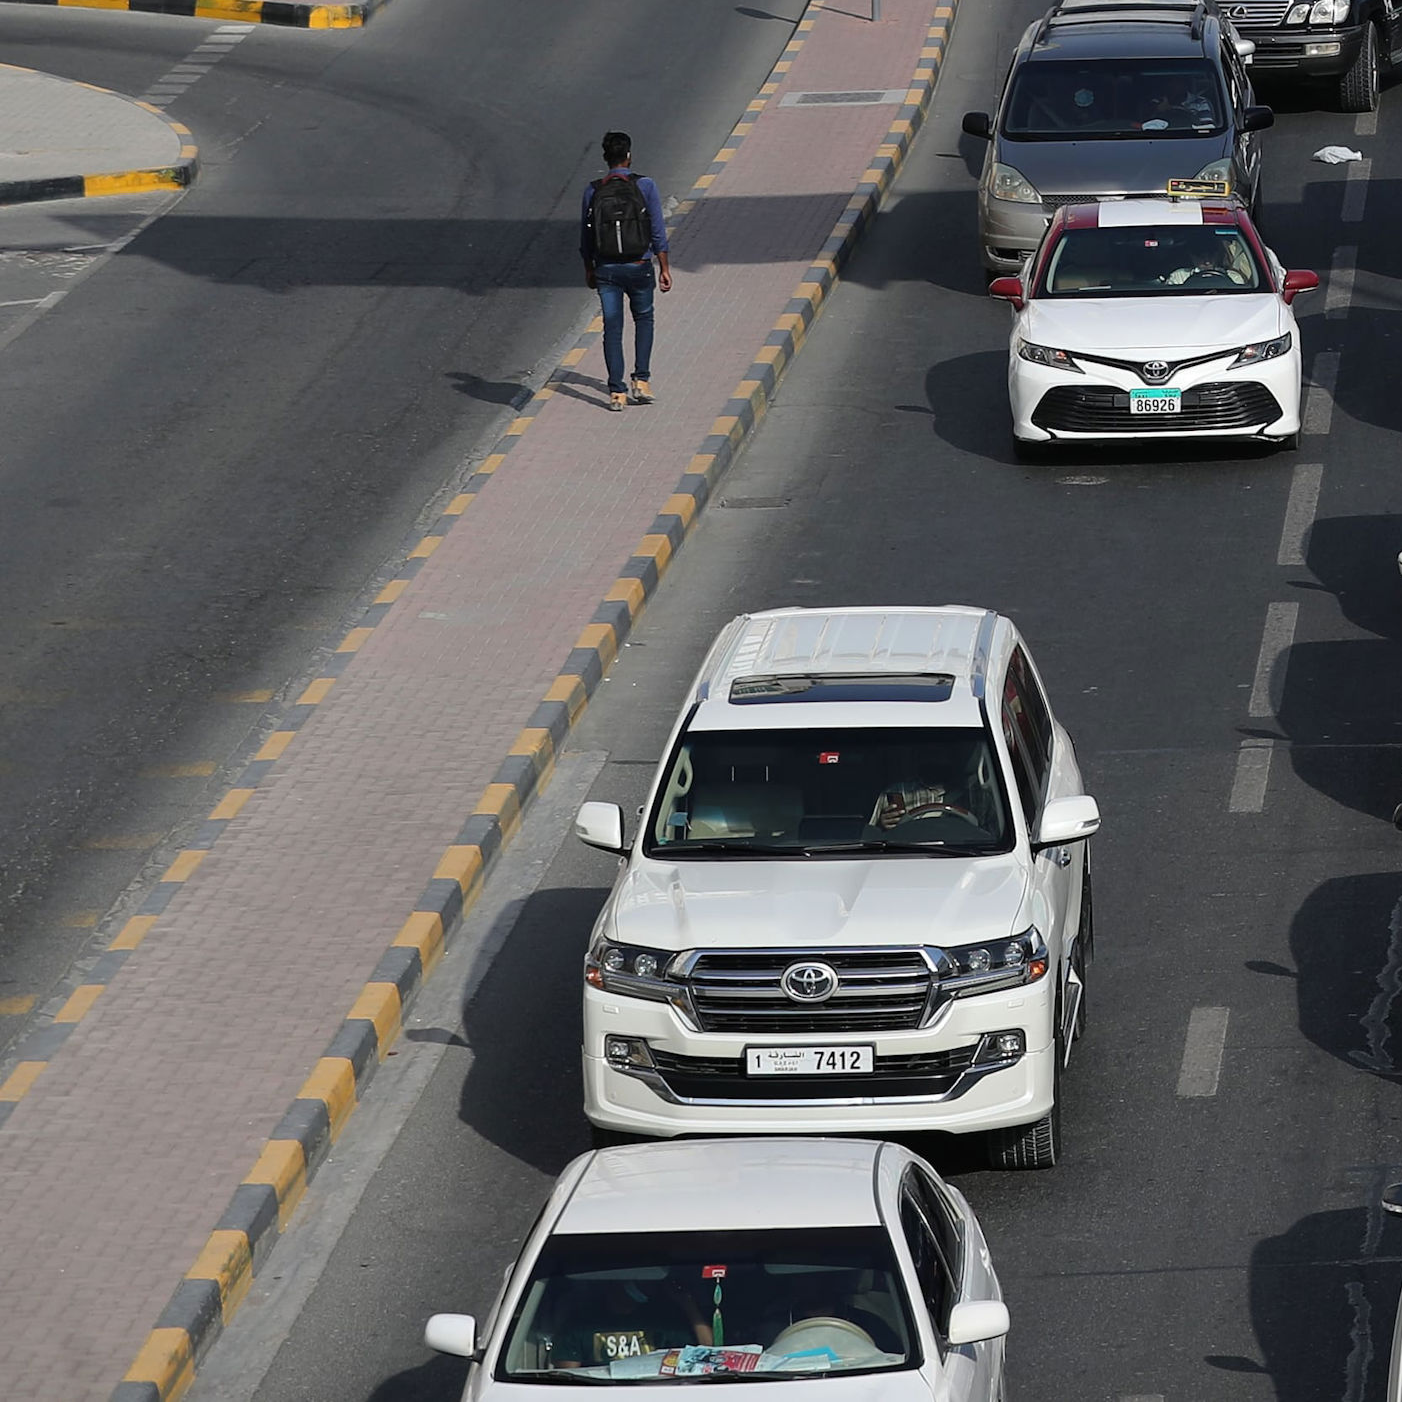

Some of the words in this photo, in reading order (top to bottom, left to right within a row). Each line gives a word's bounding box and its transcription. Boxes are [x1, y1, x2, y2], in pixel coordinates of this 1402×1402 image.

[1136, 398, 1176, 413] 86926
[755, 1054, 761, 1069] 1
[813, 1050, 862, 1071] 7412
[606, 1335, 641, 1358] S&A
